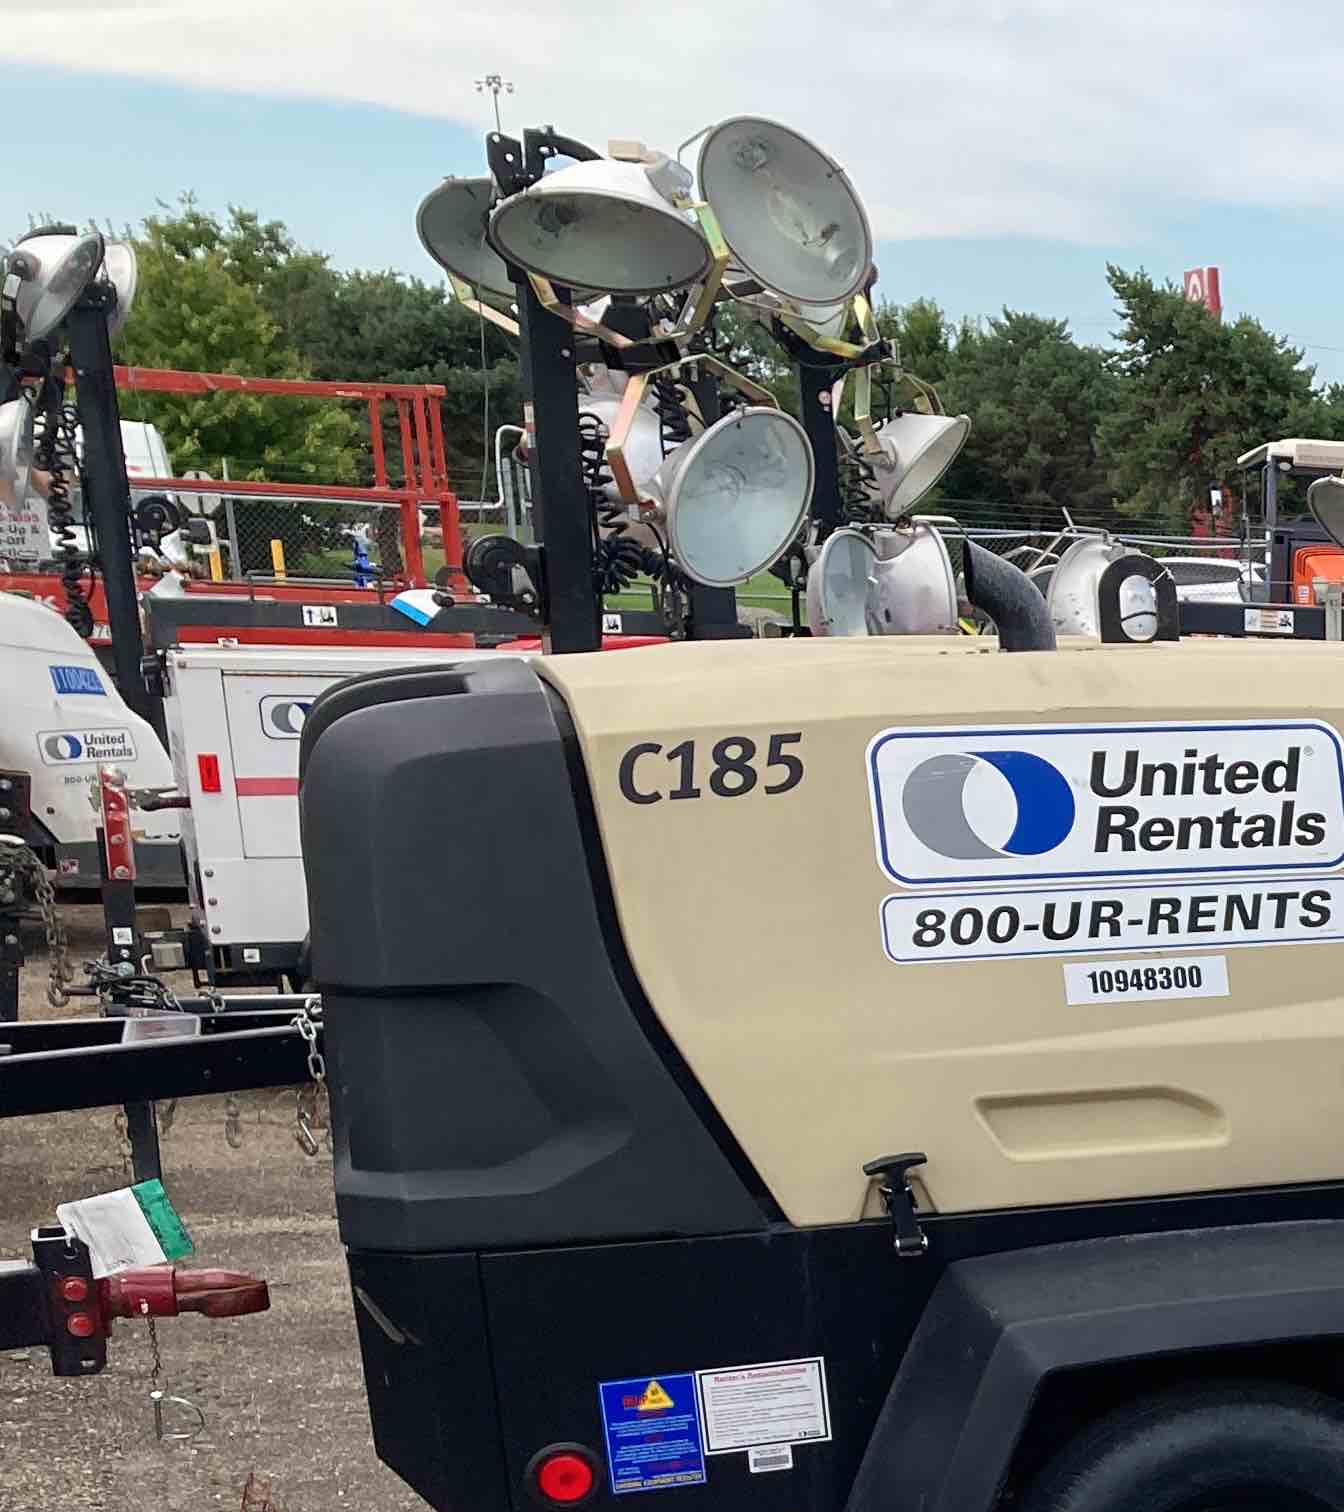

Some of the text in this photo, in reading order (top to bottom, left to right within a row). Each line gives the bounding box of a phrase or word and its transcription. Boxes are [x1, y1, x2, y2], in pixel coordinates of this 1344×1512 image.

[84, 733, 126, 745] United
[87, 746, 133, 758] Rentals
[618, 731, 805, 805] C185
[1089, 746, 1301, 799] United
[1093, 803, 1327, 853] Rentals
[911, 889, 1333, 949] 800-UR-RENTS
[1086, 965, 1203, 995] 10948300
